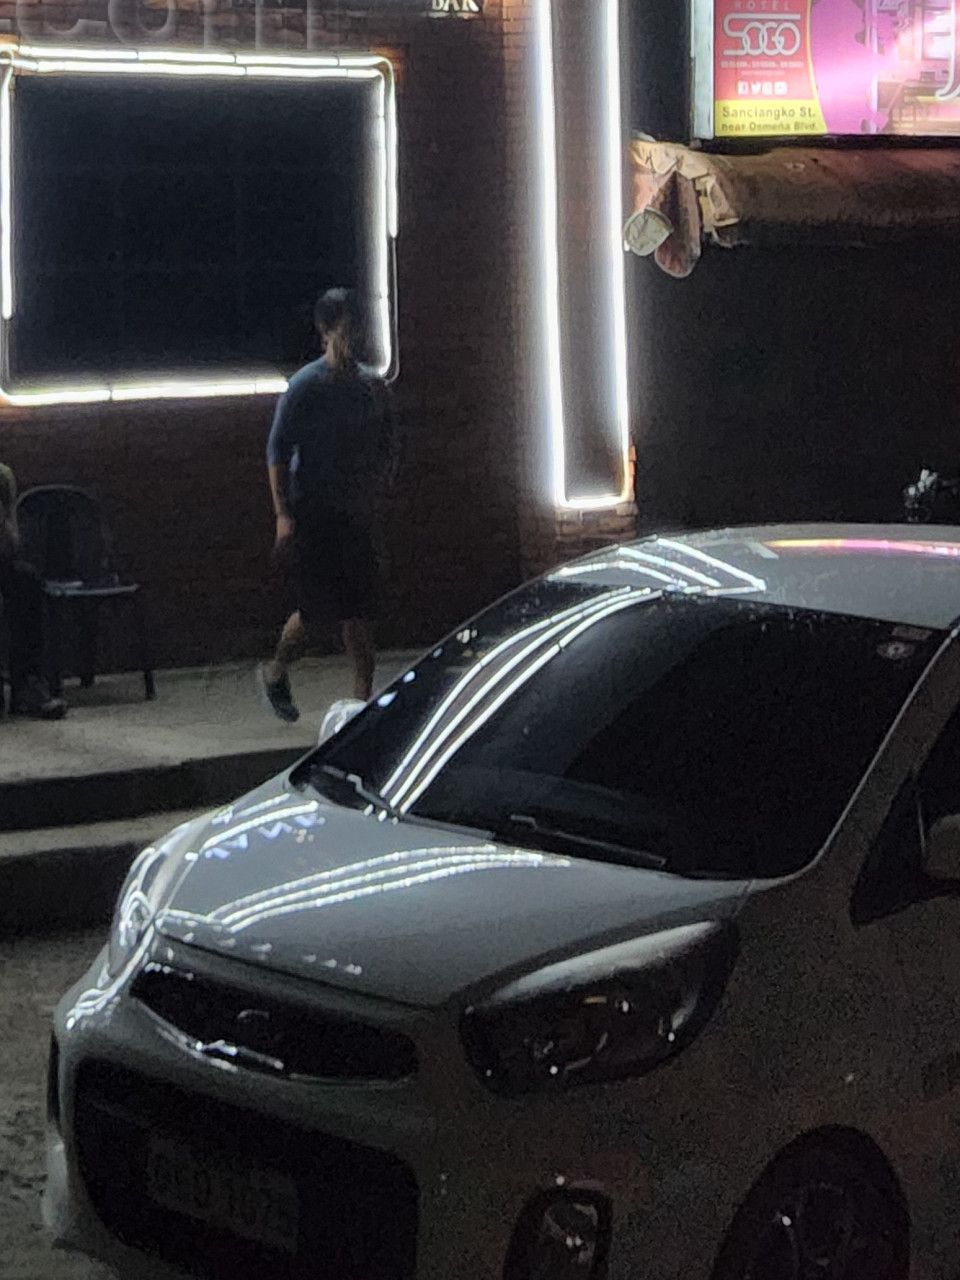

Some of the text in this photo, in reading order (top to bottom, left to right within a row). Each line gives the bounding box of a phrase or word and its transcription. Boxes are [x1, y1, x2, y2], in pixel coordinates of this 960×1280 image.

[722, 12, 801, 56] SOGO
[722, 106, 815, 120] Sanciangko St.
[721, 122, 746, 132] near
